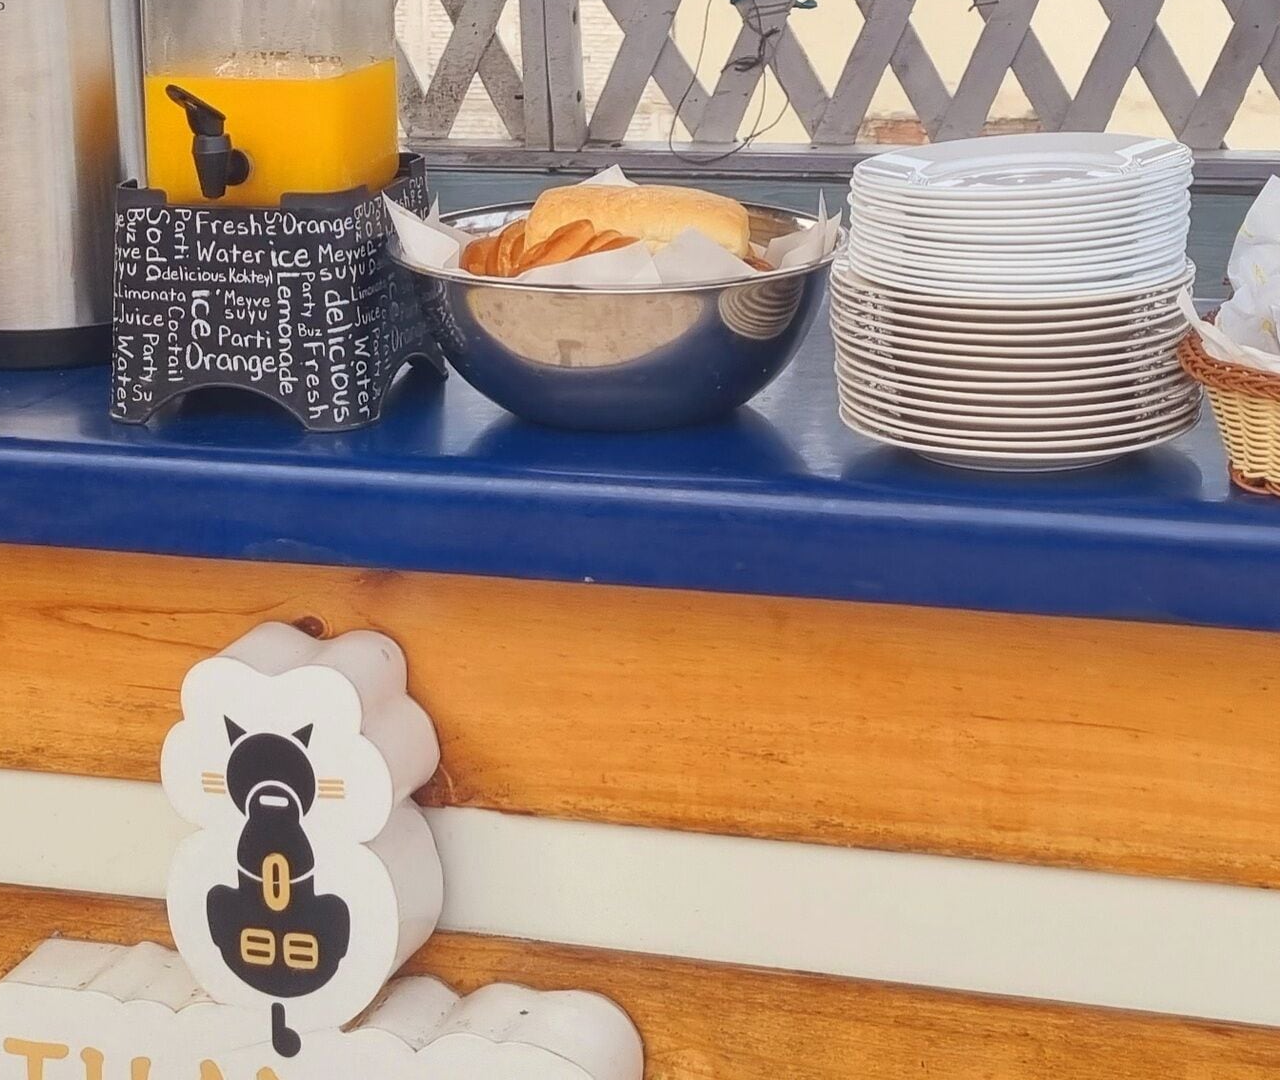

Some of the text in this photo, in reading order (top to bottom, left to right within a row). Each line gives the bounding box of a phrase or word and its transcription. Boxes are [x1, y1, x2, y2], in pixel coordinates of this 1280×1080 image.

[126, 208, 145, 243] Buz
[174, 208, 192, 260] Parti
[195, 211, 263, 236] Fresh
[263, 211, 282, 236] Su
[282, 212, 354, 240] Orange
[353, 204, 364, 243] Buz
[146, 207, 171, 282] Soda
[196, 240, 266, 264] Water
[268, 239, 312, 268] ice
[318, 242, 367, 265] Meyve
[161, 266, 227, 282] delicious
[319, 263, 366, 284] suyu
[117, 281, 187, 303] Limonata
[223, 289, 272, 311] Meyve
[300, 271, 316, 318] Party
[118, 302, 165, 327] Juice
[224, 308, 269, 325] suyu
[168, 305, 186, 382] Coctail
[218, 324, 272, 349] Parti
[276, 271, 300, 396] Lemonade
[297, 322, 323, 338] Buz
[138, 332, 160, 384] Party
[184, 341, 278, 383] Orange
[324, 289, 355, 423] delicious
[116, 335, 135, 415] Water
[302, 341, 330, 420] Fresh
[353, 335, 372, 419] Water
[131, 383, 154, 402] Su
